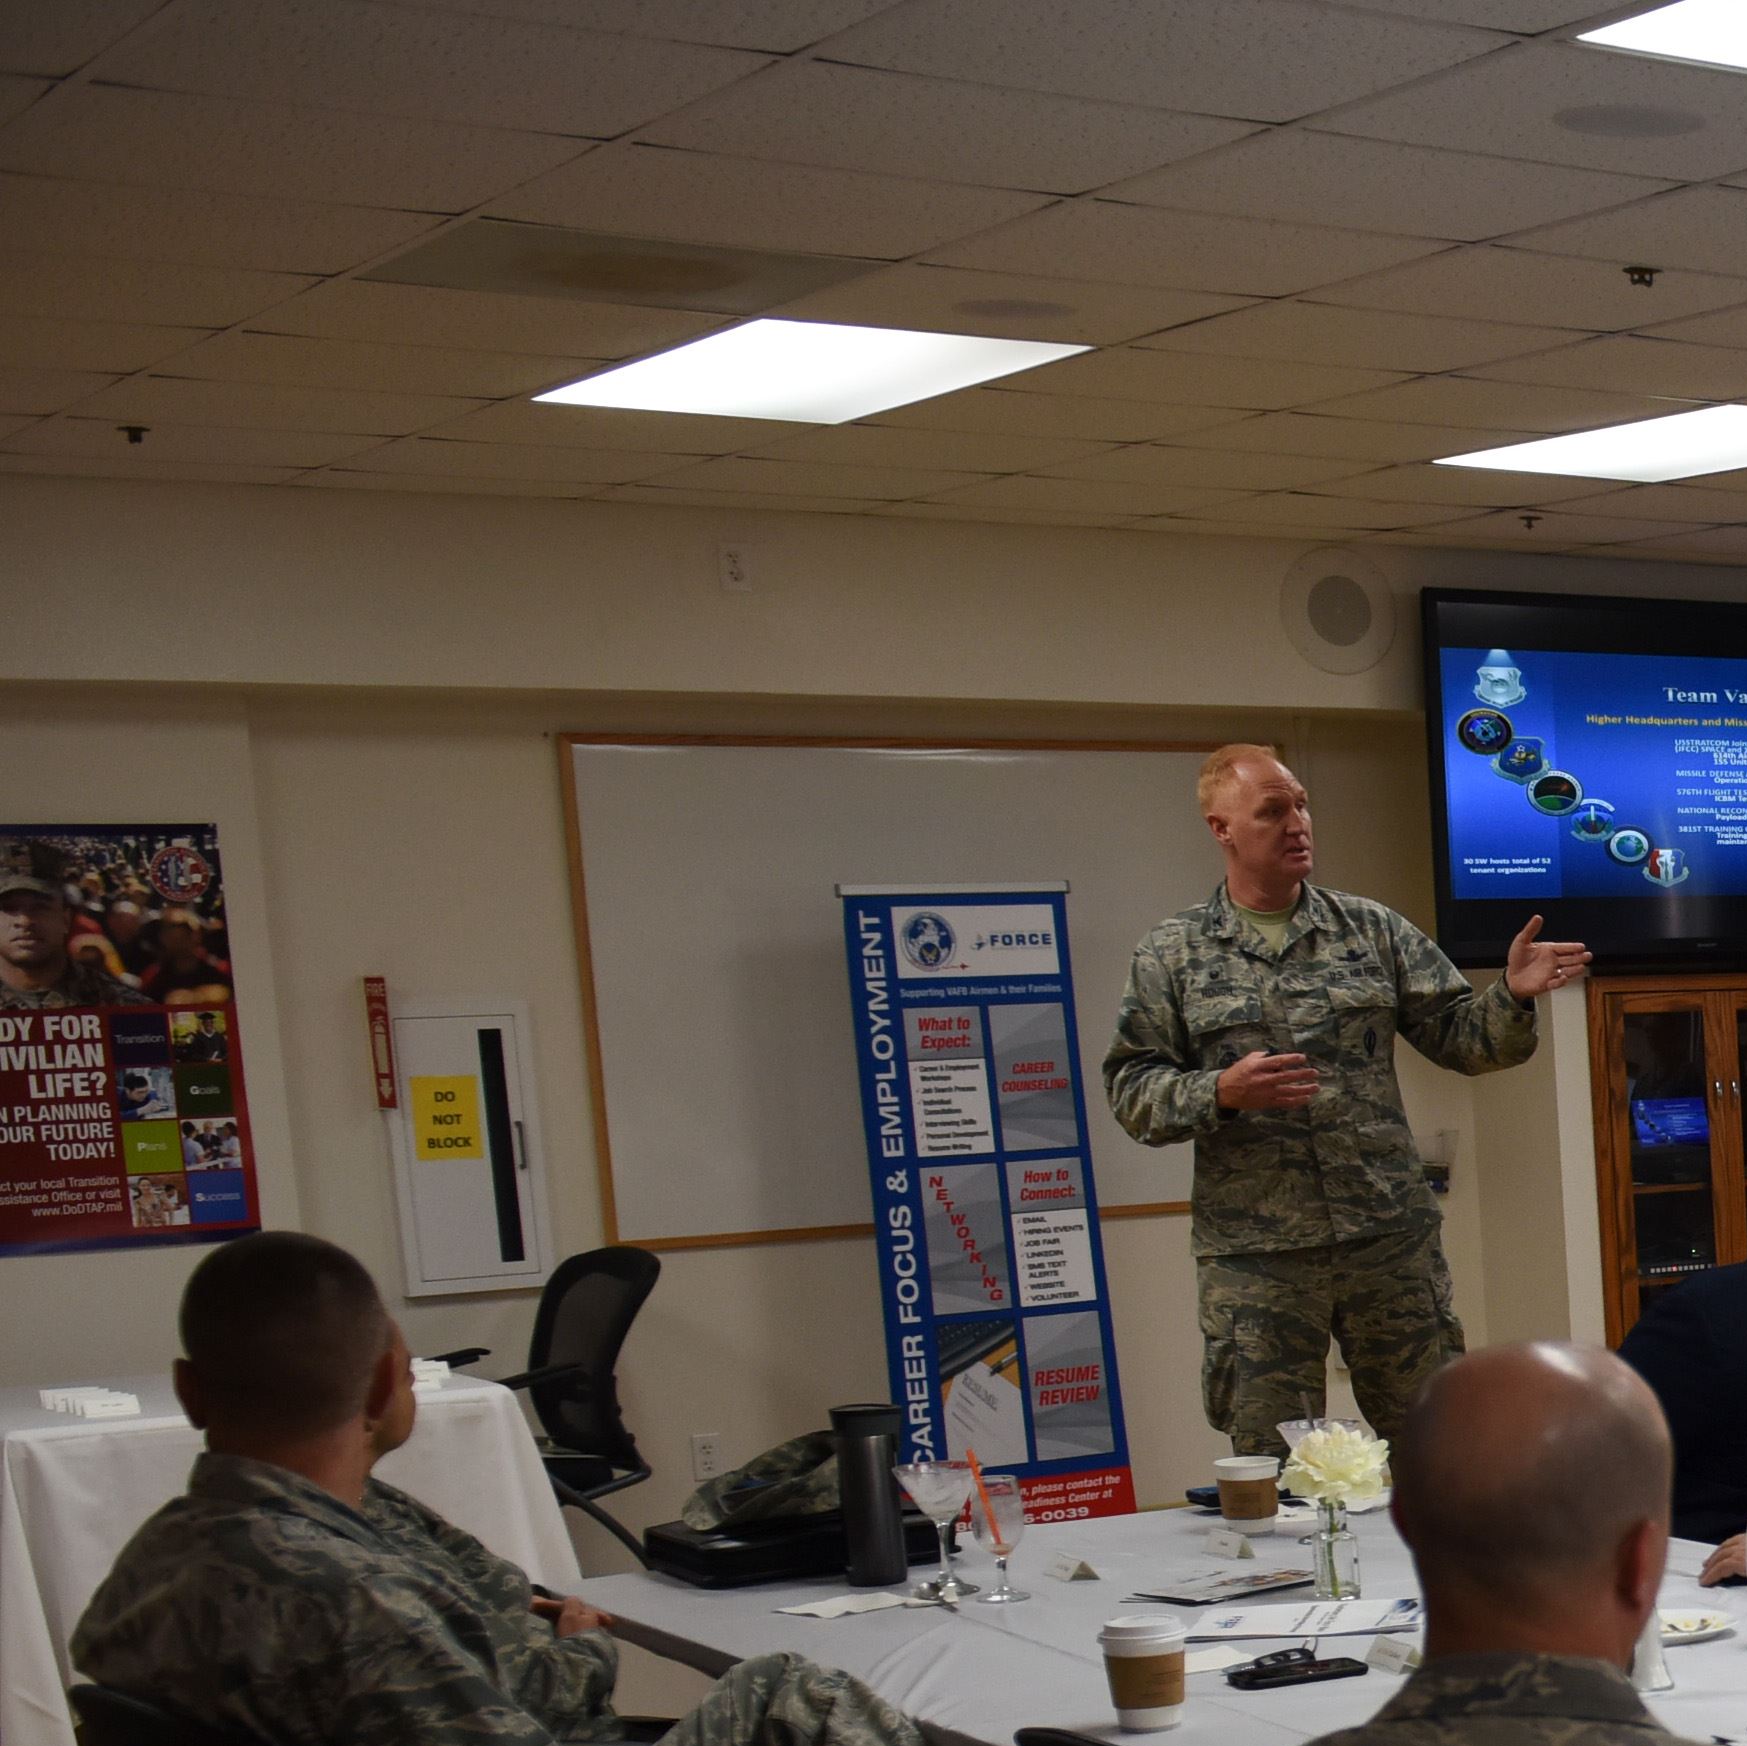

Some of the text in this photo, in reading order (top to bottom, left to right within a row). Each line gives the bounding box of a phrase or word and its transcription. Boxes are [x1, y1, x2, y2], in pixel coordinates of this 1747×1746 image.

[1662, 687, 1718, 704] Team
[1586, 714, 1622, 726] Higher
[1625, 715, 1698, 727] Headquarters
[1702, 717, 1721, 726] and
[989, 932, 1052, 947] FORCE
[366, 983, 386, 997] FIRE
[900, 987, 945, 999] Supporting
[947, 986, 969, 996] VAFB
[970, 985, 998, 996] Airmen
[1008, 984, 1026, 994] their
[43, 1014, 102, 1041] FOR
[918, 1016, 970, 1031] What to
[114, 1033, 165, 1045] Transition
[921, 1034, 972, 1052] Expect:
[1012, 1062, 1054, 1074] CAREER
[28, 1071, 108, 1099] LIFE?
[189, 1085, 221, 1095] Goals
[1002, 1078, 1069, 1092] COUNSELING
[434, 1091, 456, 1103] DO
[13, 1102, 112, 1123] PLANNING
[432, 1114, 463, 1126] NOT
[41, 1121, 114, 1141] FUTURE
[427, 1137, 472, 1149] BLOCK
[46, 1141, 116, 1161] TODAY!
[1024, 1169, 1069, 1183] How to
[13, 1181, 38, 1192] your
[40, 1177, 66, 1189] local
[69, 1176, 119, 1188] Transition
[858, 909, 936, 1465] CAREER FOCUS & EMPLOYMENT
[51, 1190, 83, 1202] Office
[85, 1192, 96, 1201] or
[99, 1188, 121, 1200] visit
[195, 1191, 241, 1202] Success
[1020, 1185, 1076, 1202] Connect:
[31, 1202, 123, 1217] www.DoDTAP.mil
[1024, 1224, 1084, 1236] HIRING EVENTS
[929, 1176, 1003, 1301] NETWORKING
[1042, 1238, 1060, 1246] FAIR
[1028, 1270, 1059, 1279] ALERTS
[1030, 1281, 1065, 1290] WEBSITE
[1032, 1291, 1080, 1301] VOLUNTEER
[1034, 1365, 1100, 1387] RESUME
[961, 1373, 998, 1412] RESUME
[1039, 1386, 1100, 1407] REVIEW
[1032, 1482, 1064, 1496] please
[1066, 1477, 1103, 1490] contact
[1105, 1475, 1121, 1486] the
[1024, 1489, 1113, 1508] eadiness Center at
